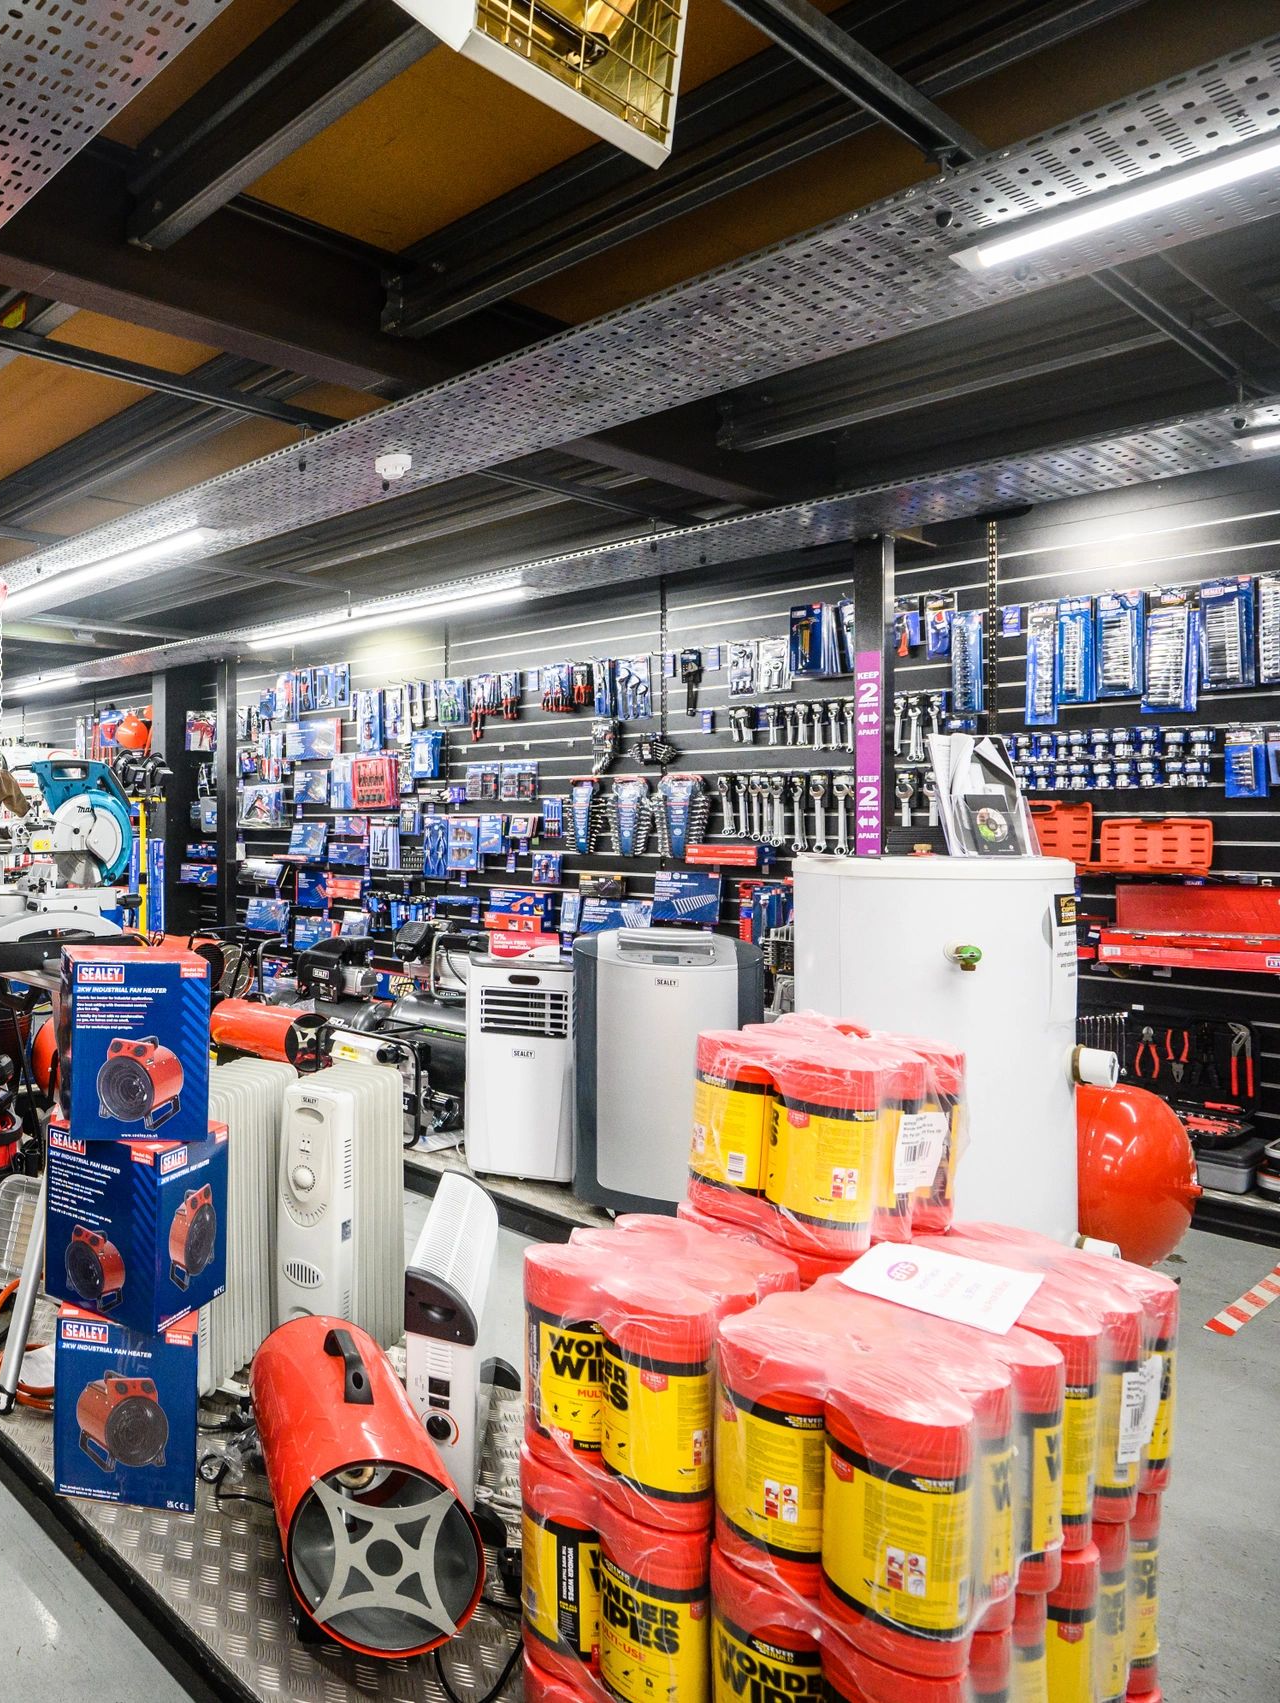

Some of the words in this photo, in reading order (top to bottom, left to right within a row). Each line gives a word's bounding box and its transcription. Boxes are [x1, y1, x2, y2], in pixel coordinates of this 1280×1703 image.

[857, 671, 879, 679] KEEP
[859, 683, 878, 702] 2
[858, 775, 879, 783] KEEP
[859, 786, 878, 806] 2
[81, 968, 120, 980] SEALEY
[656, 978, 676, 986] SEALEY
[513, 1050, 534, 1058] SEALEY
[53, 1133, 82, 1152] SEALEY
[61, 1153, 89, 1166] INDUSTRIAL
[100, 1165, 120, 1174] HEATER
[163, 1150, 186, 1170] SEALEY
[66, 1324, 104, 1340] SEALEY
[77, 1344, 113, 1354] INDUSTRIAL
[114, 1347, 127, 1355] FAN
[128, 1350, 152, 1358] HEATER
[767, 1644, 794, 1657] EVER
